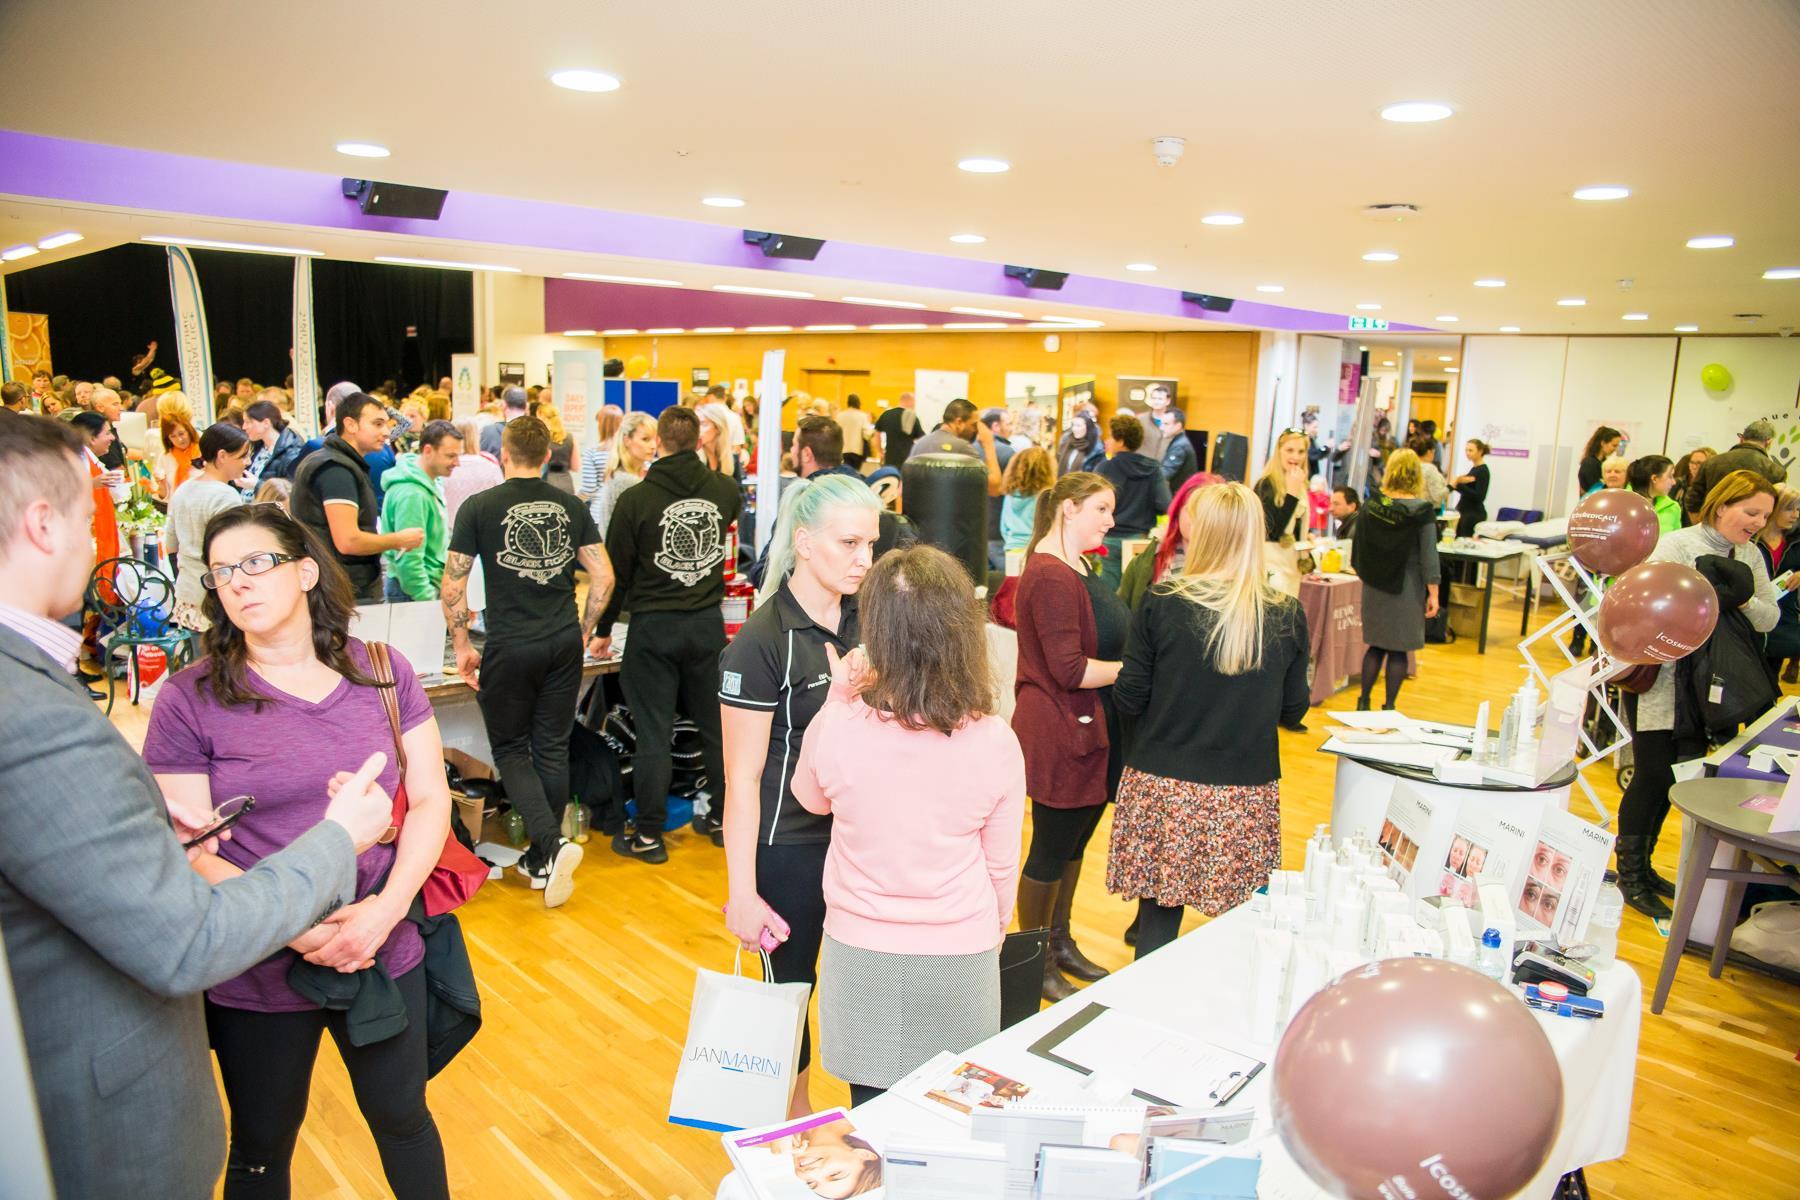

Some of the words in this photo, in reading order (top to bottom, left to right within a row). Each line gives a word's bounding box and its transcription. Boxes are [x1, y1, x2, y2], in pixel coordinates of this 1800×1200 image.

[503, 554, 542, 568] BLACK
[660, 556, 695, 570] BLACK
[1500, 821, 1526, 838] MARINI
[1583, 828, 1609, 846] MARINI
